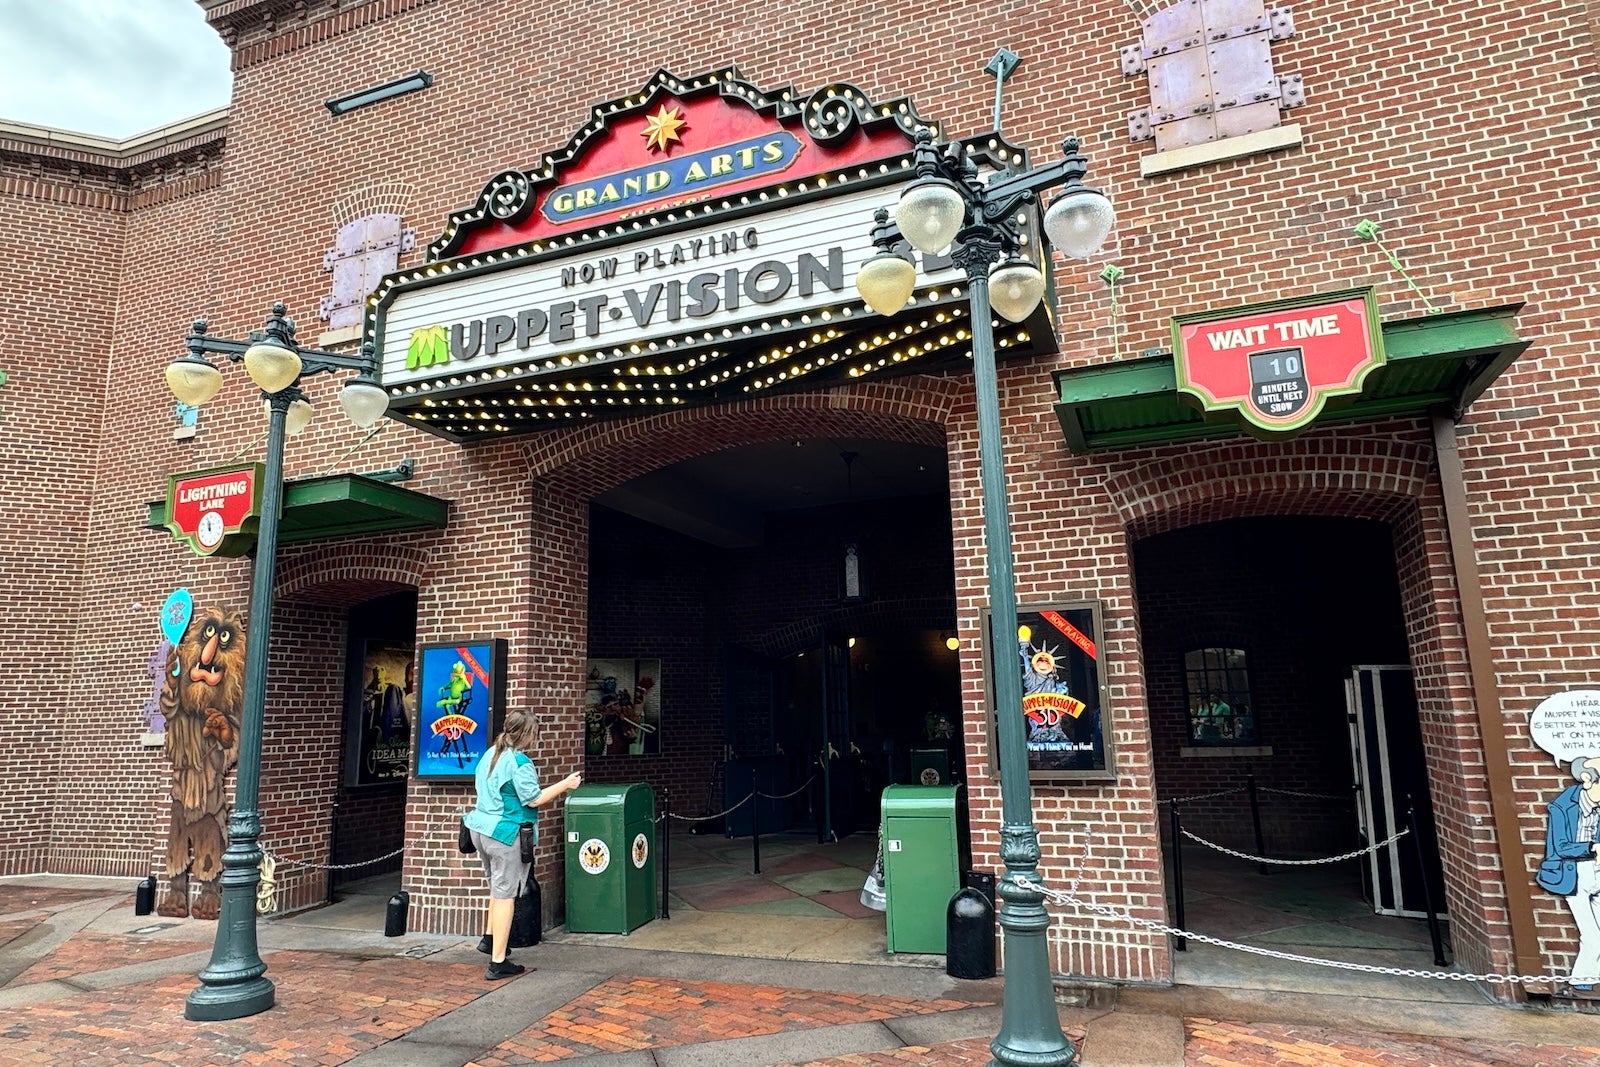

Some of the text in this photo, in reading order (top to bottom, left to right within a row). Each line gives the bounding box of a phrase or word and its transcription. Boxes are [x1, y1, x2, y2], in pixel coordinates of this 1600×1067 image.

[553, 140, 785, 214] GRAND ARTS
[561, 227, 759, 288] NOW PLAYING
[1206, 314, 1341, 352] WAIT TIME
[1270, 356, 1299, 376] 10
[1261, 381, 1298, 395] MINUTES
[1257, 390, 1303, 405] UNTIL NEXT
[1270, 402, 1293, 413] SHOW
[180, 481, 248, 504] LIGHTNING
[199, 498, 225, 511] LANE
[1050, 613, 1091, 650] NOW PLAYING
[1023, 696, 1046, 711] UPPET
[1576, 699, 1600, 707] HEAR
[1036, 708, 1060, 725] 3D
[1543, 721, 1576, 729] BETTER
[446, 726, 461, 740] 3D
[1552, 731, 1565, 739] HIT
[1570, 731, 1584, 739] ON
[372, 748, 395, 760] IDEA
